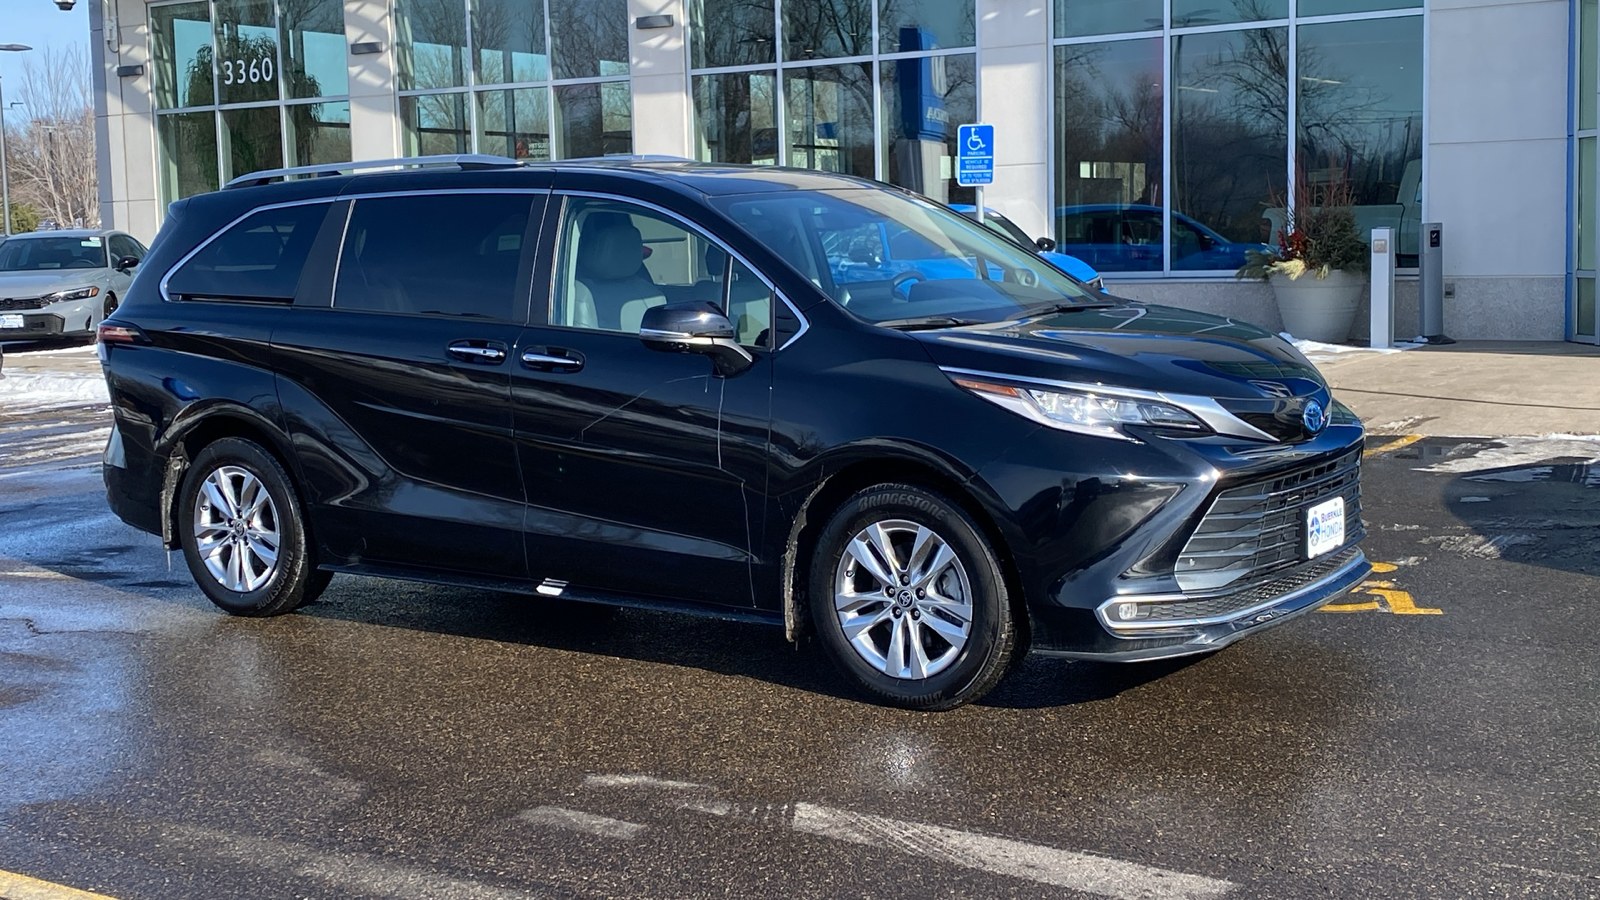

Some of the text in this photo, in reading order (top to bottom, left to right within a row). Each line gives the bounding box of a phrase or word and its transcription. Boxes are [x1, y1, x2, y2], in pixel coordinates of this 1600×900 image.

[223, 57, 273, 85] 3360
[859, 493, 947, 520] BRIDGESTONE
[1321, 520, 1343, 541] HONDA
[256, 549, 294, 610] BRIDGESTONE
